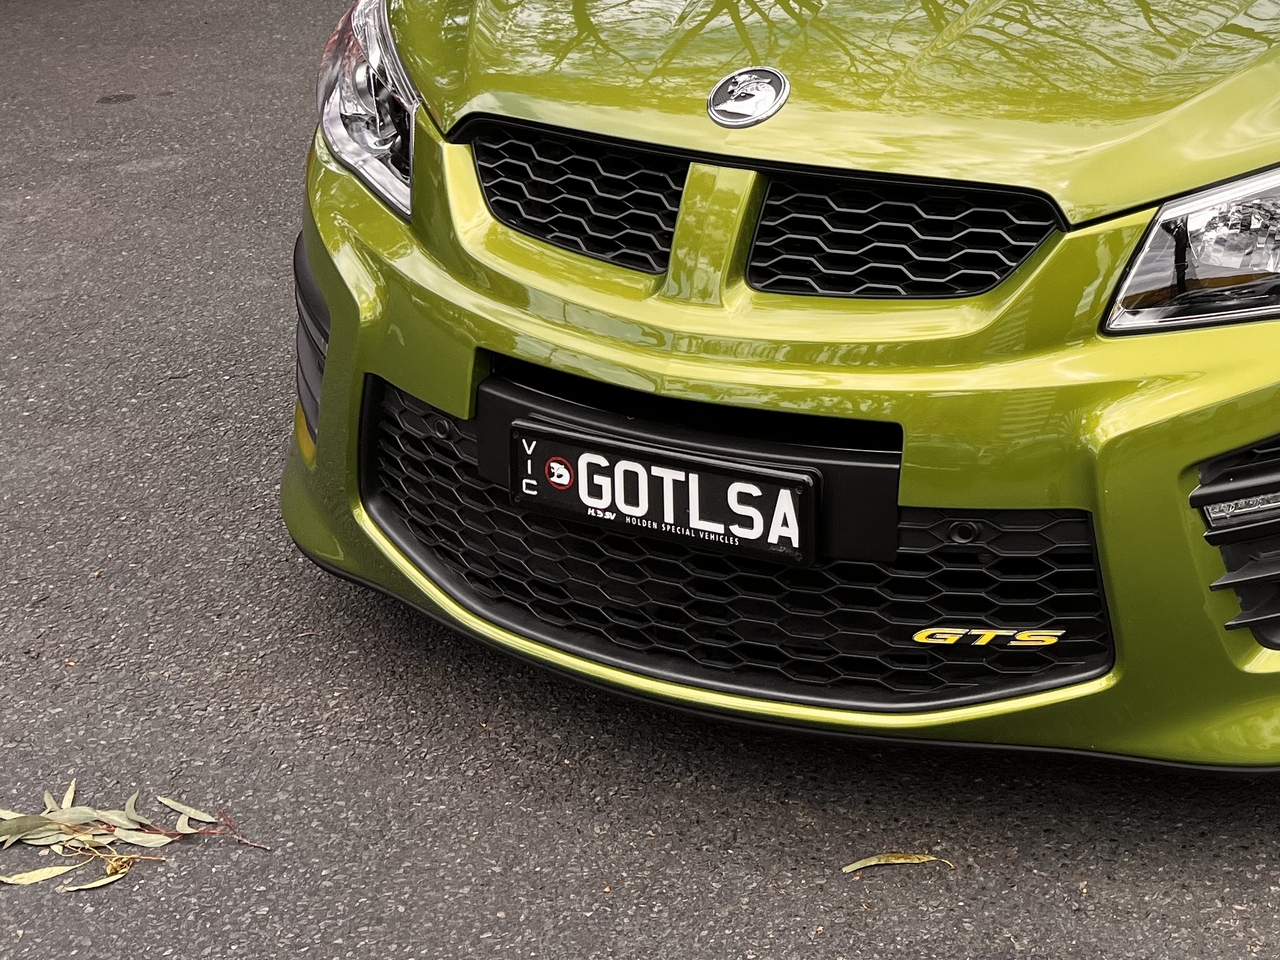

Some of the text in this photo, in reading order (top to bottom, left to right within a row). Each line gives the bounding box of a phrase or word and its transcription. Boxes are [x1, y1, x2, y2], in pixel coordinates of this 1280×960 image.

[521, 438, 538, 496] VIC
[577, 452, 800, 548] GOTLSA
[625, 516, 740, 546] HOLDEN SPECIAL VEHICLES
[912, 627, 1066, 646] GTS
